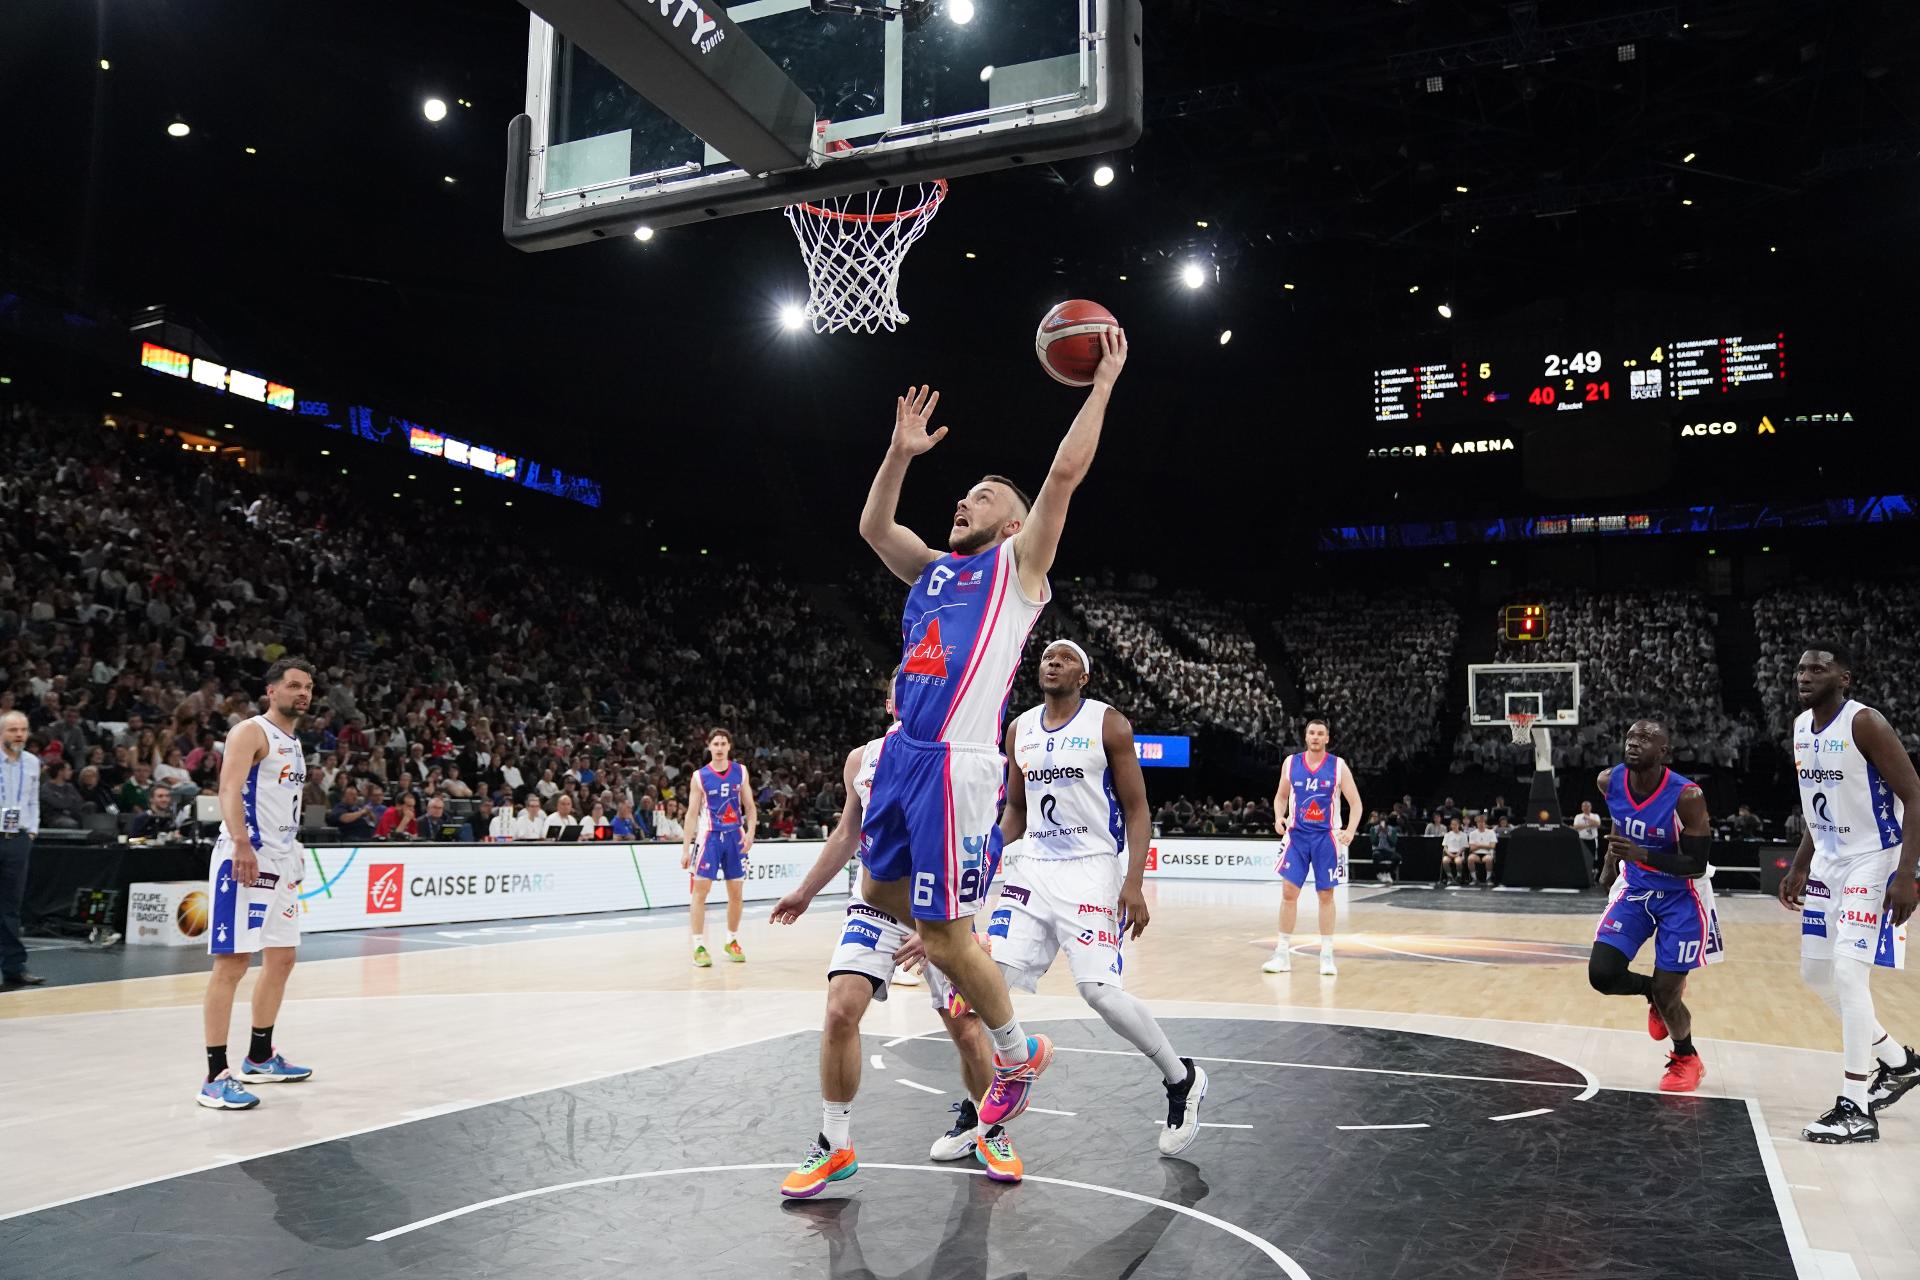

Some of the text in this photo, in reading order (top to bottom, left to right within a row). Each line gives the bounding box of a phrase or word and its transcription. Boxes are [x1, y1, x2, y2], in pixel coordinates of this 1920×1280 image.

[648, 0, 716, 44] RTY
[700, 28, 725, 54] Sports
[1650, 346, 1664, 363] 4
[1479, 363, 1491, 379] 5
[1544, 351, 1602, 377] 2:49
[1565, 378, 1574, 391] 2
[1585, 381, 1610, 401] 21
[1528, 386, 1555, 405] 40
[1451, 438, 1515, 455] ARENA
[926, 564, 956, 596] 6
[1046, 737, 1055, 752] 6
[1813, 739, 1820, 753] 9
[720, 783, 730, 797] 5
[1305, 777, 1318, 792] 14
[1059, 826, 1088, 836] ROYER
[1624, 816, 1646, 840] 10
[1162, 854, 1209, 865] CAISSE
[1328, 867, 1339, 882] 14
[410, 875, 477, 897] CAISSE
[913, 871, 936, 907] 6
[131, 892, 161, 902] COUPE
[132, 902, 166, 913] FRANCE
[136, 912, 169, 923] BASKET
[1847, 910, 1877, 925] BLM
[1677, 940, 1701, 964] 10
